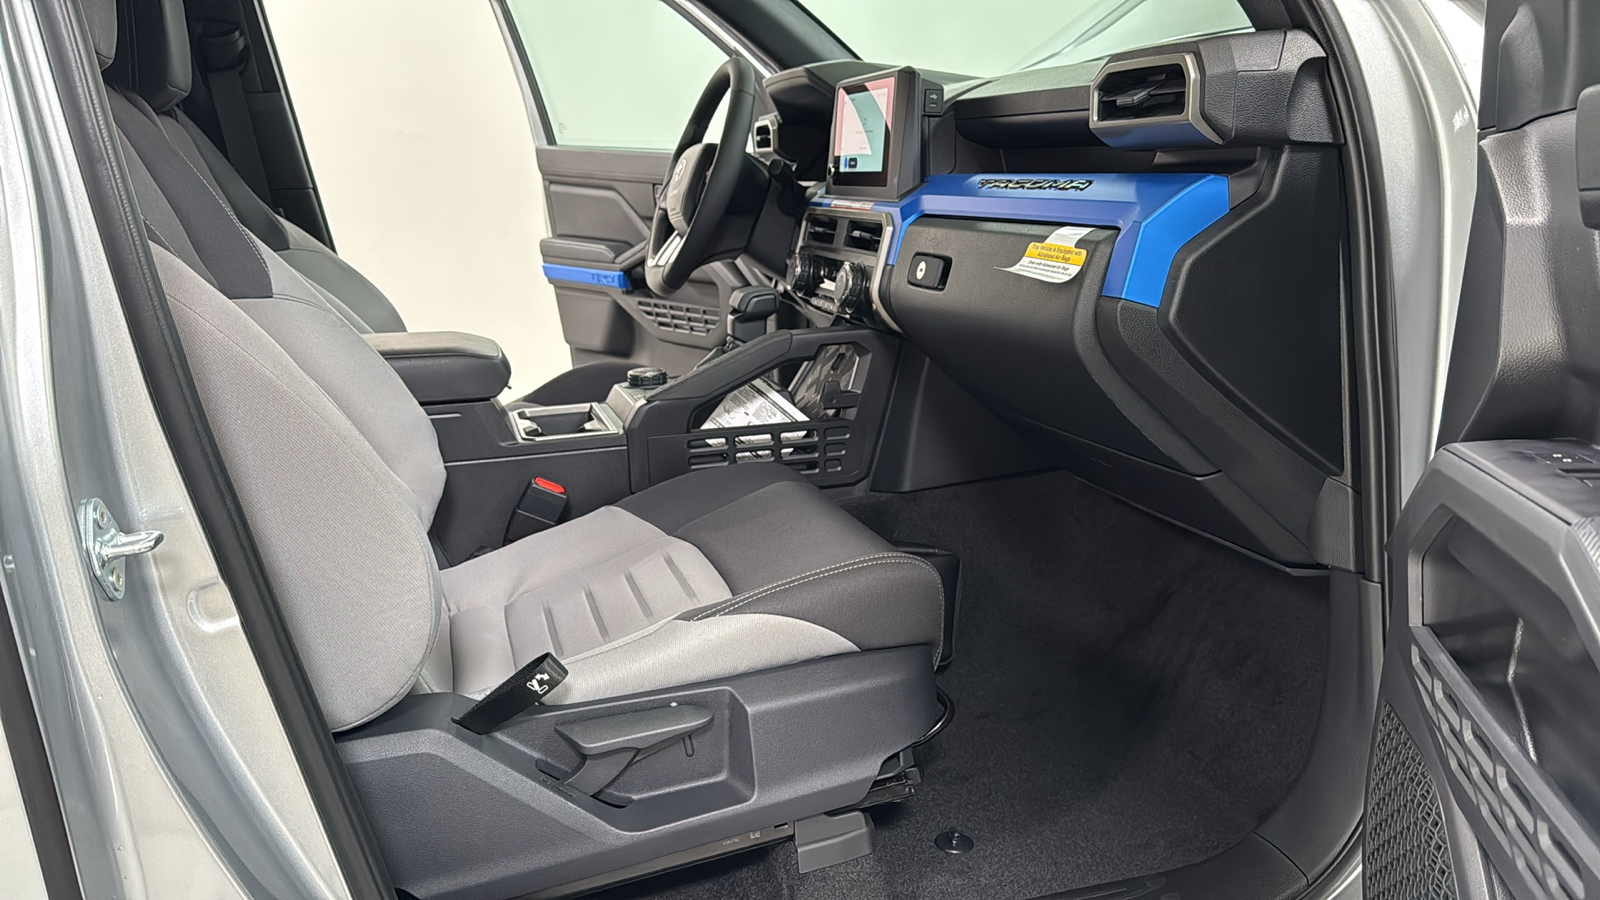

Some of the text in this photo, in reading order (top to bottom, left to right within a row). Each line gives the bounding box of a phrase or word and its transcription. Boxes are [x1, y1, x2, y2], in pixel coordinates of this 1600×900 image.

[978, 179, 1094, 191] TACOMA
[1056, 248, 1074, 256] Equipped
[1061, 255, 1071, 263] Bags
